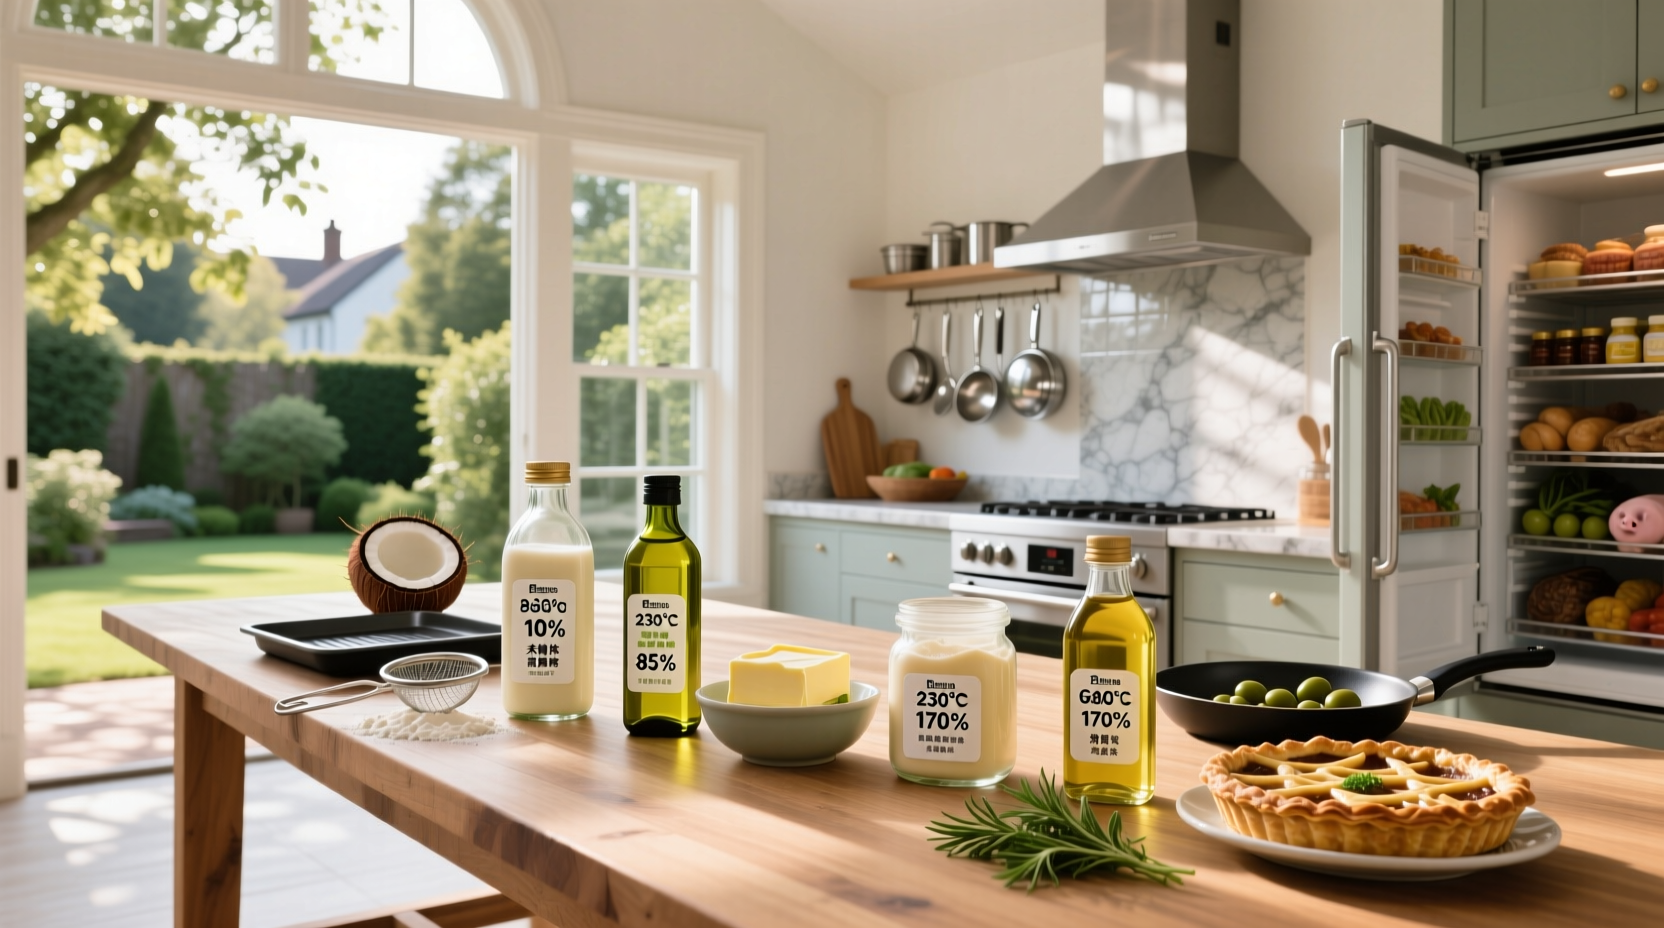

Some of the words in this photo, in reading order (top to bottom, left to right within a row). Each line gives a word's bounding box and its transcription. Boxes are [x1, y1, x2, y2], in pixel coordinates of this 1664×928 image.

[524, 619, 565, 637] 10%
[636, 612, 678, 626] 230°C
[636, 653, 676, 671] 85%
[916, 691, 968, 708] 230°C
[916, 711, 969, 730] 170%
[1082, 710, 1130, 728] 170%
